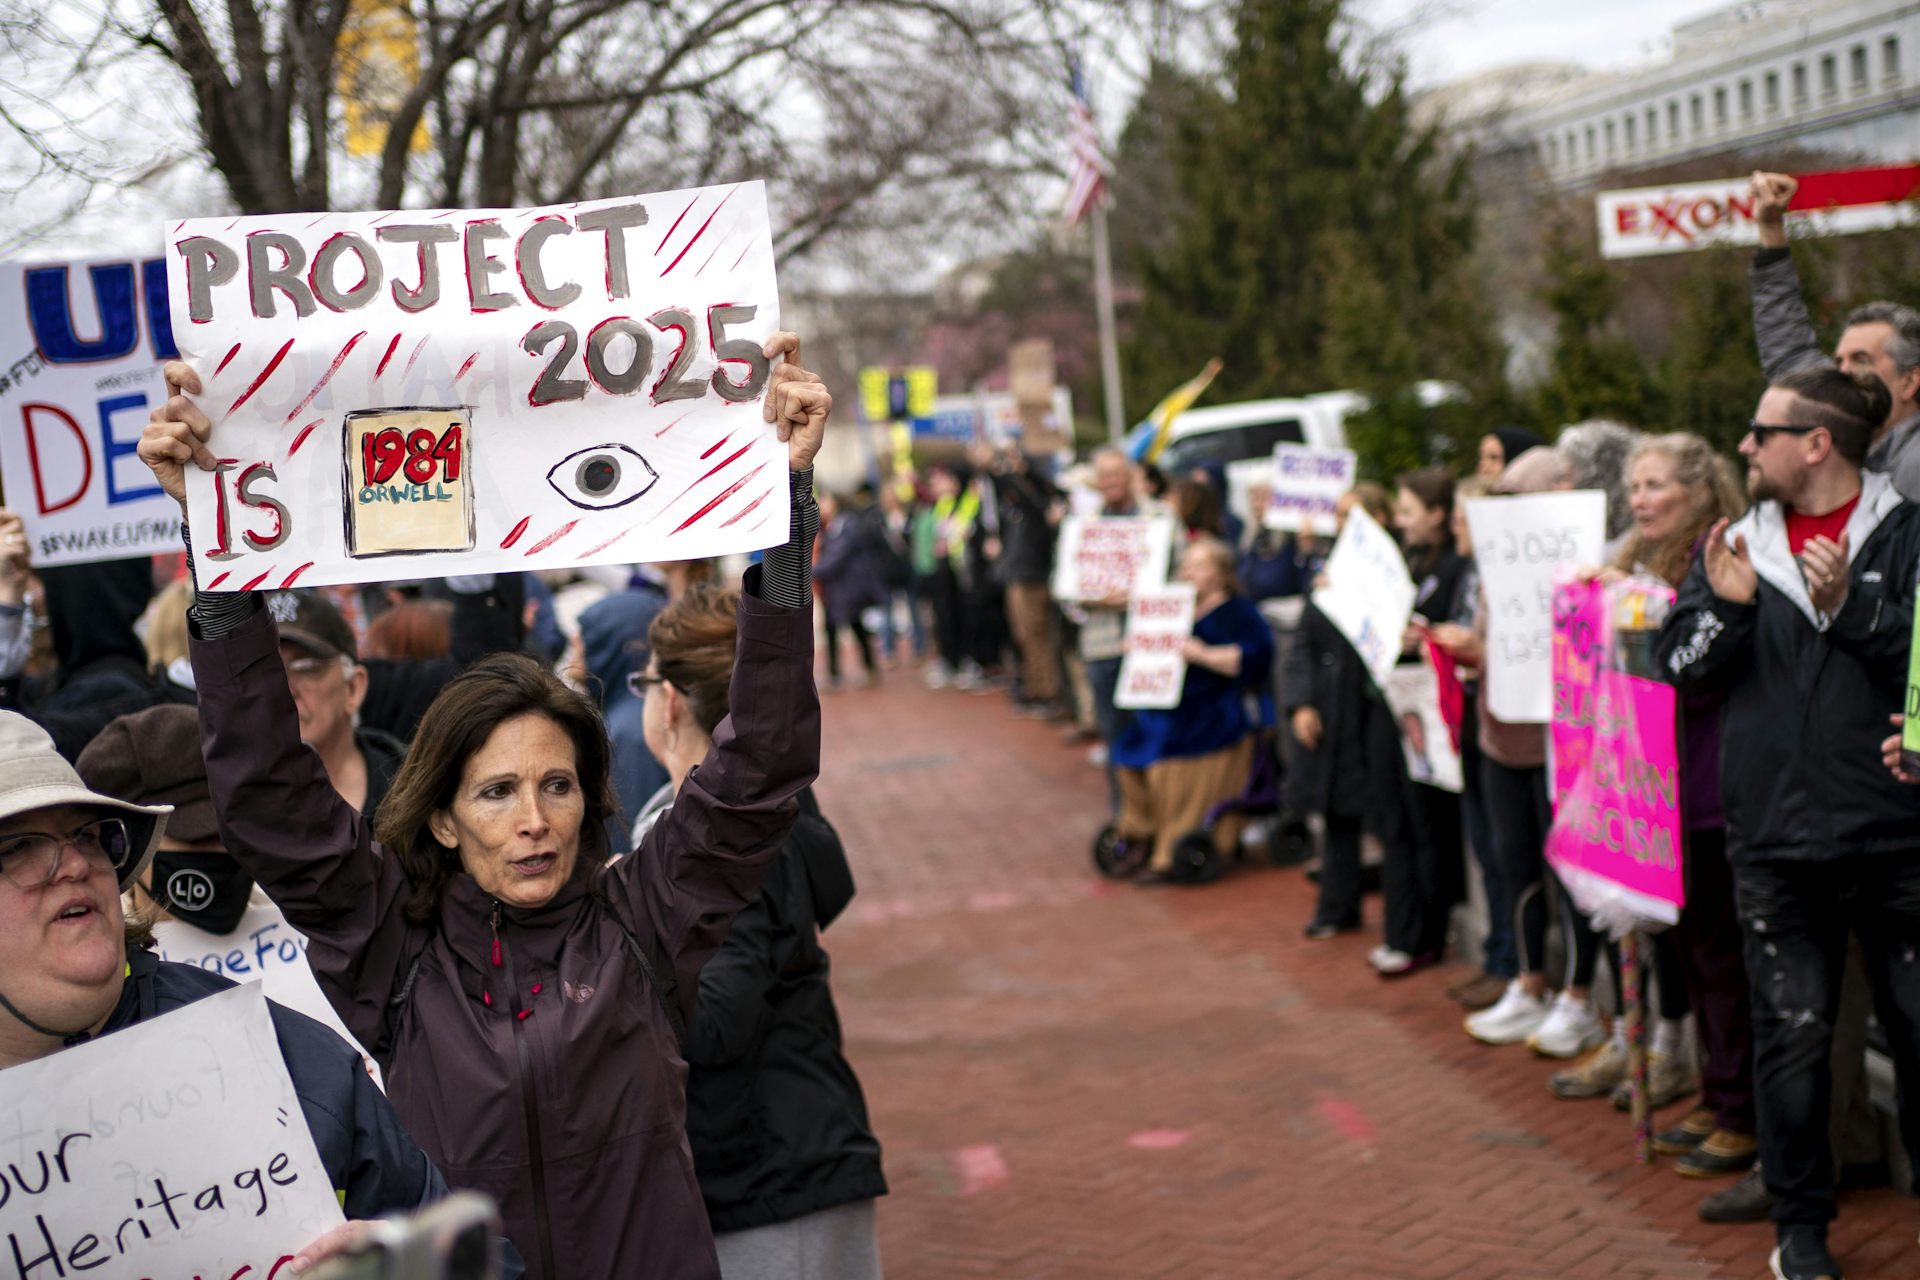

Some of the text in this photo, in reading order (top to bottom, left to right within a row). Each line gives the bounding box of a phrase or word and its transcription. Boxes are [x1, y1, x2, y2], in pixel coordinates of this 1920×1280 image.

[176, 203, 649, 323] PROJECT
[520, 301, 772, 408] 2025
[358, 482, 453, 505] ORWELL
[362, 422, 462, 487] 1984
[205, 457, 292, 562] IS
[1594, 748, 1678, 812] BURN
